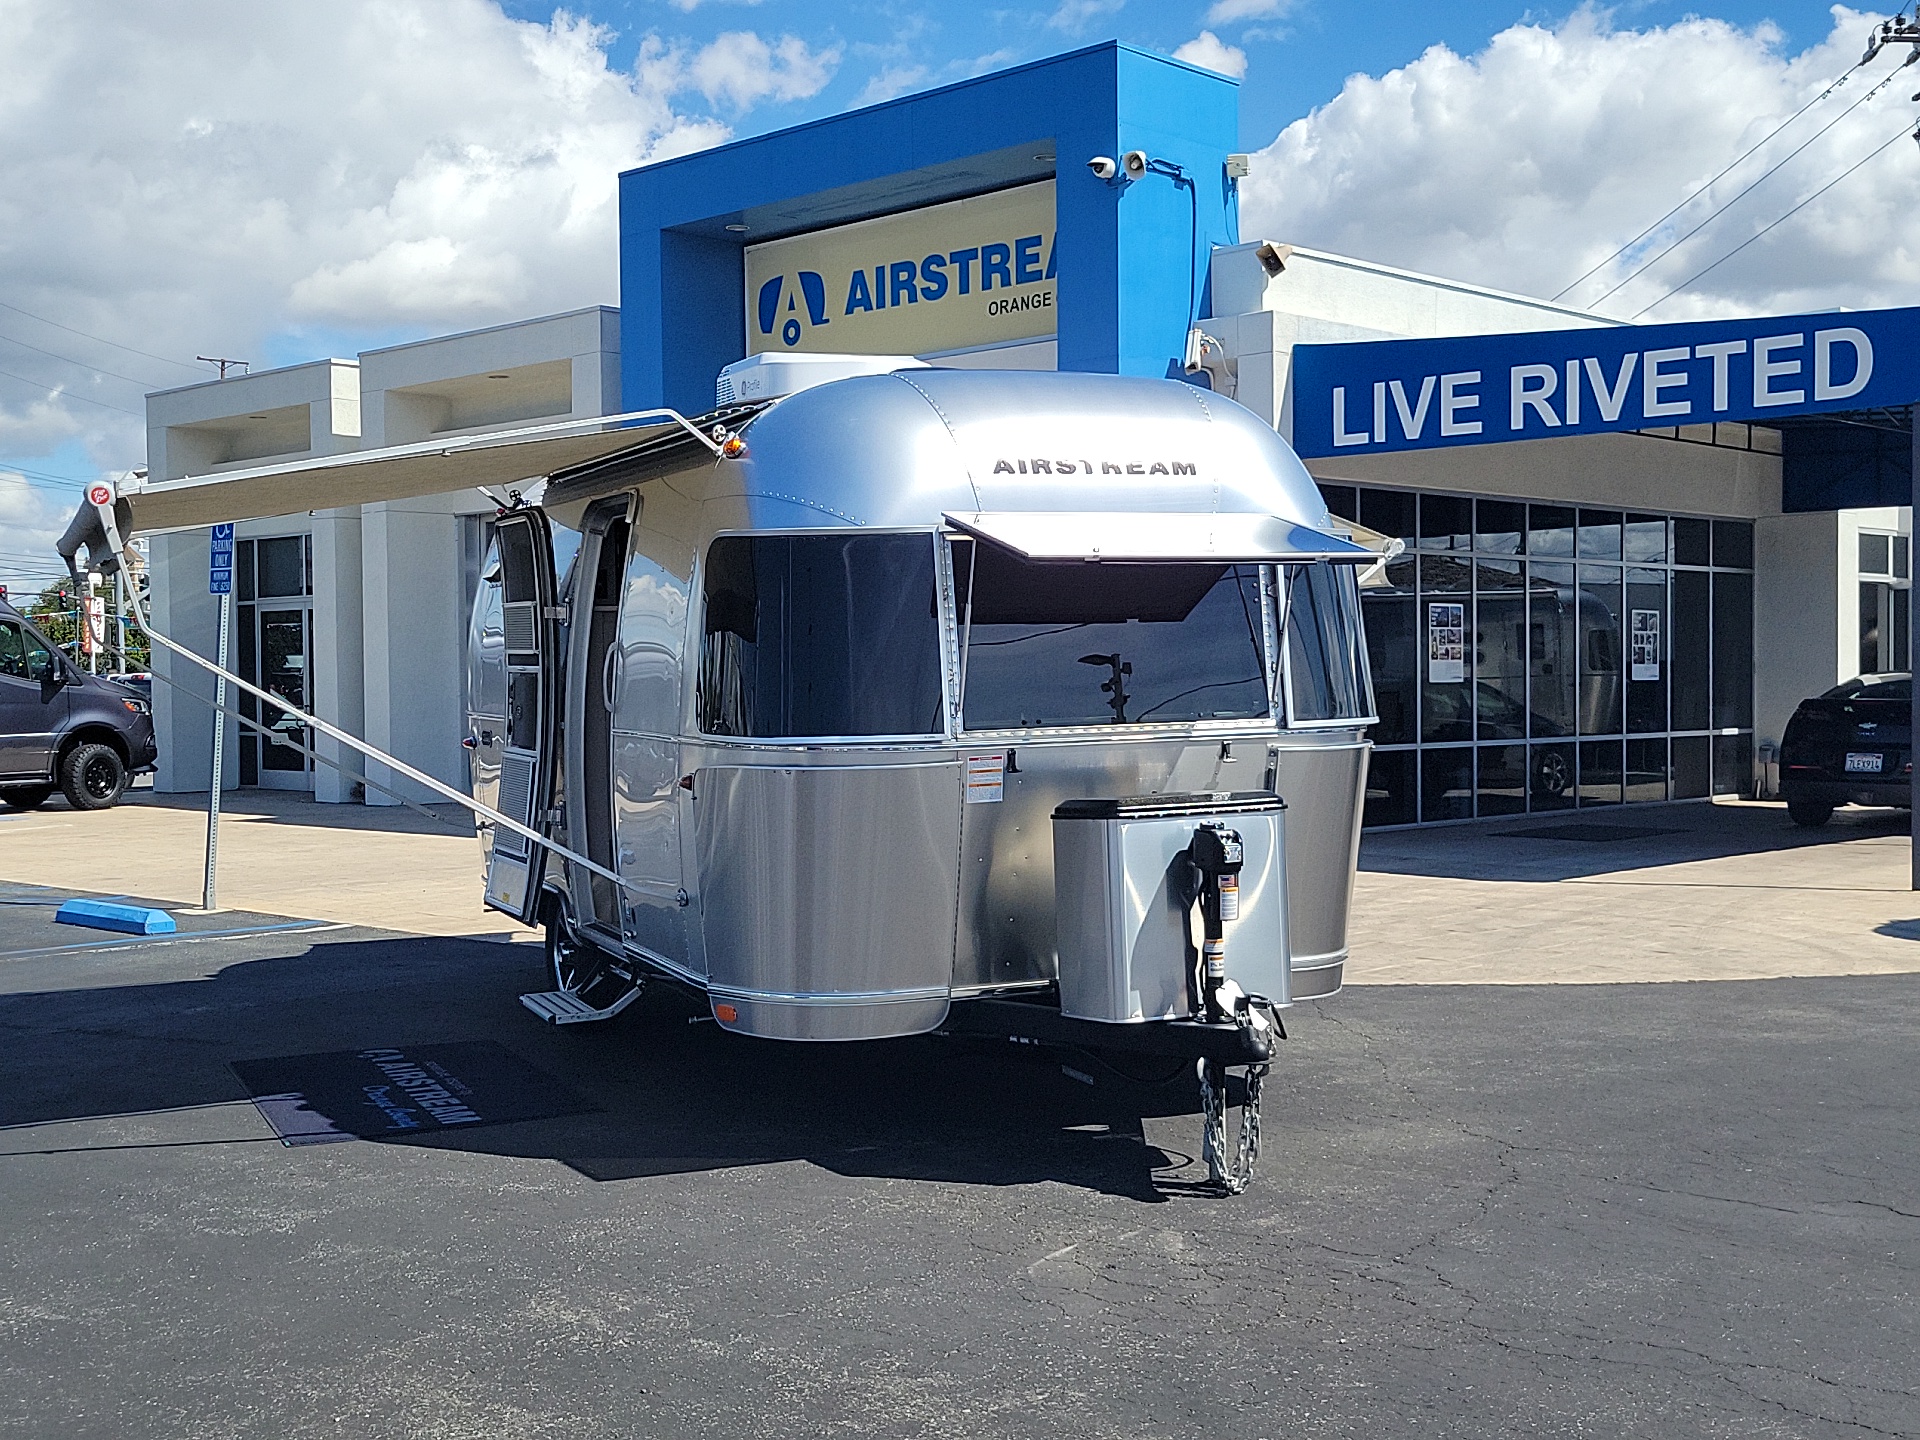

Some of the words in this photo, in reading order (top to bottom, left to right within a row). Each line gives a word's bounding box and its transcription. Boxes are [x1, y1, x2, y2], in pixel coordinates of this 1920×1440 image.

[988, 291, 1052, 316] ORANGE
[1332, 370, 1483, 447] LIVE
[1510, 327, 1874, 430] RIVETED
[993, 458, 1197, 476] AIRSTREAM
[212, 539, 232, 552] PARKING
[214, 553, 229, 567] ONLY
[377, 1062, 482, 1125] AIRSTREAM
